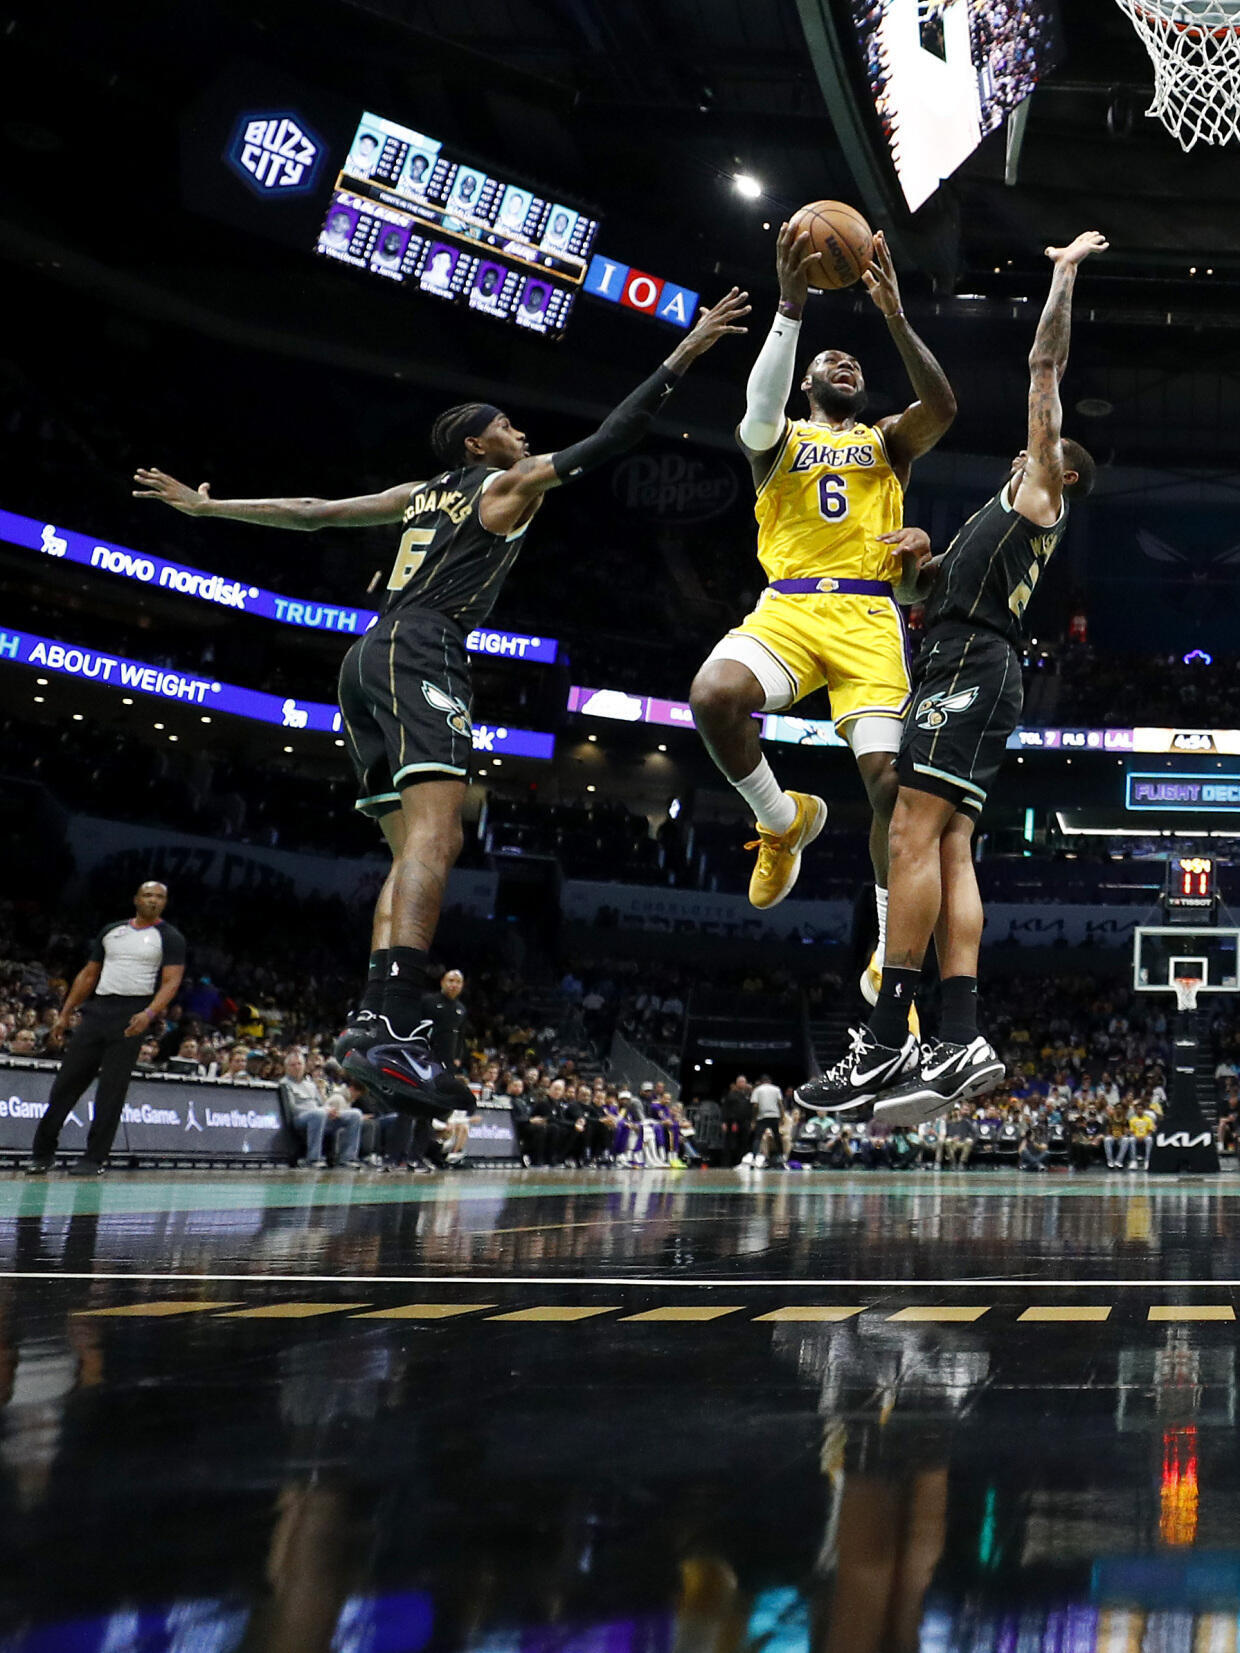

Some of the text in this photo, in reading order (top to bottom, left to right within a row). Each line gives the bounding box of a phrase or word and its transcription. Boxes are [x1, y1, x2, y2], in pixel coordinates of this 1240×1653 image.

[244, 119, 316, 165] BUZZ
[241, 144, 304, 187] CITY
[661, 453, 704, 482] Dr
[787, 441, 876, 474] LAKERS
[626, 455, 730, 514] Pepper
[818, 472, 850, 522] 6
[90, 546, 250, 610] novo nordisk
[273, 597, 357, 633] TRUTH
[464, 629, 531, 657] EIGHT
[28, 641, 118, 681] ABOUT
[120, 663, 211, 704] WEIGHT
[1045, 730, 1057, 746] 7
[1062, 732, 1086, 747] FLS
[1104, 731, 1133, 747] LAL
[1173, 734, 1212, 750] 4:54
[1134, 783, 1202, 801] FLIGHT
[1183, 872, 1207, 895] 11
[1181, 898, 1213, 907] TISSOT
[8, 1096, 50, 1119] Gam
[205, 1107, 231, 1128] Love
[230, 1108, 248, 1128] the
[1156, 1131, 1212, 1148] KIA
